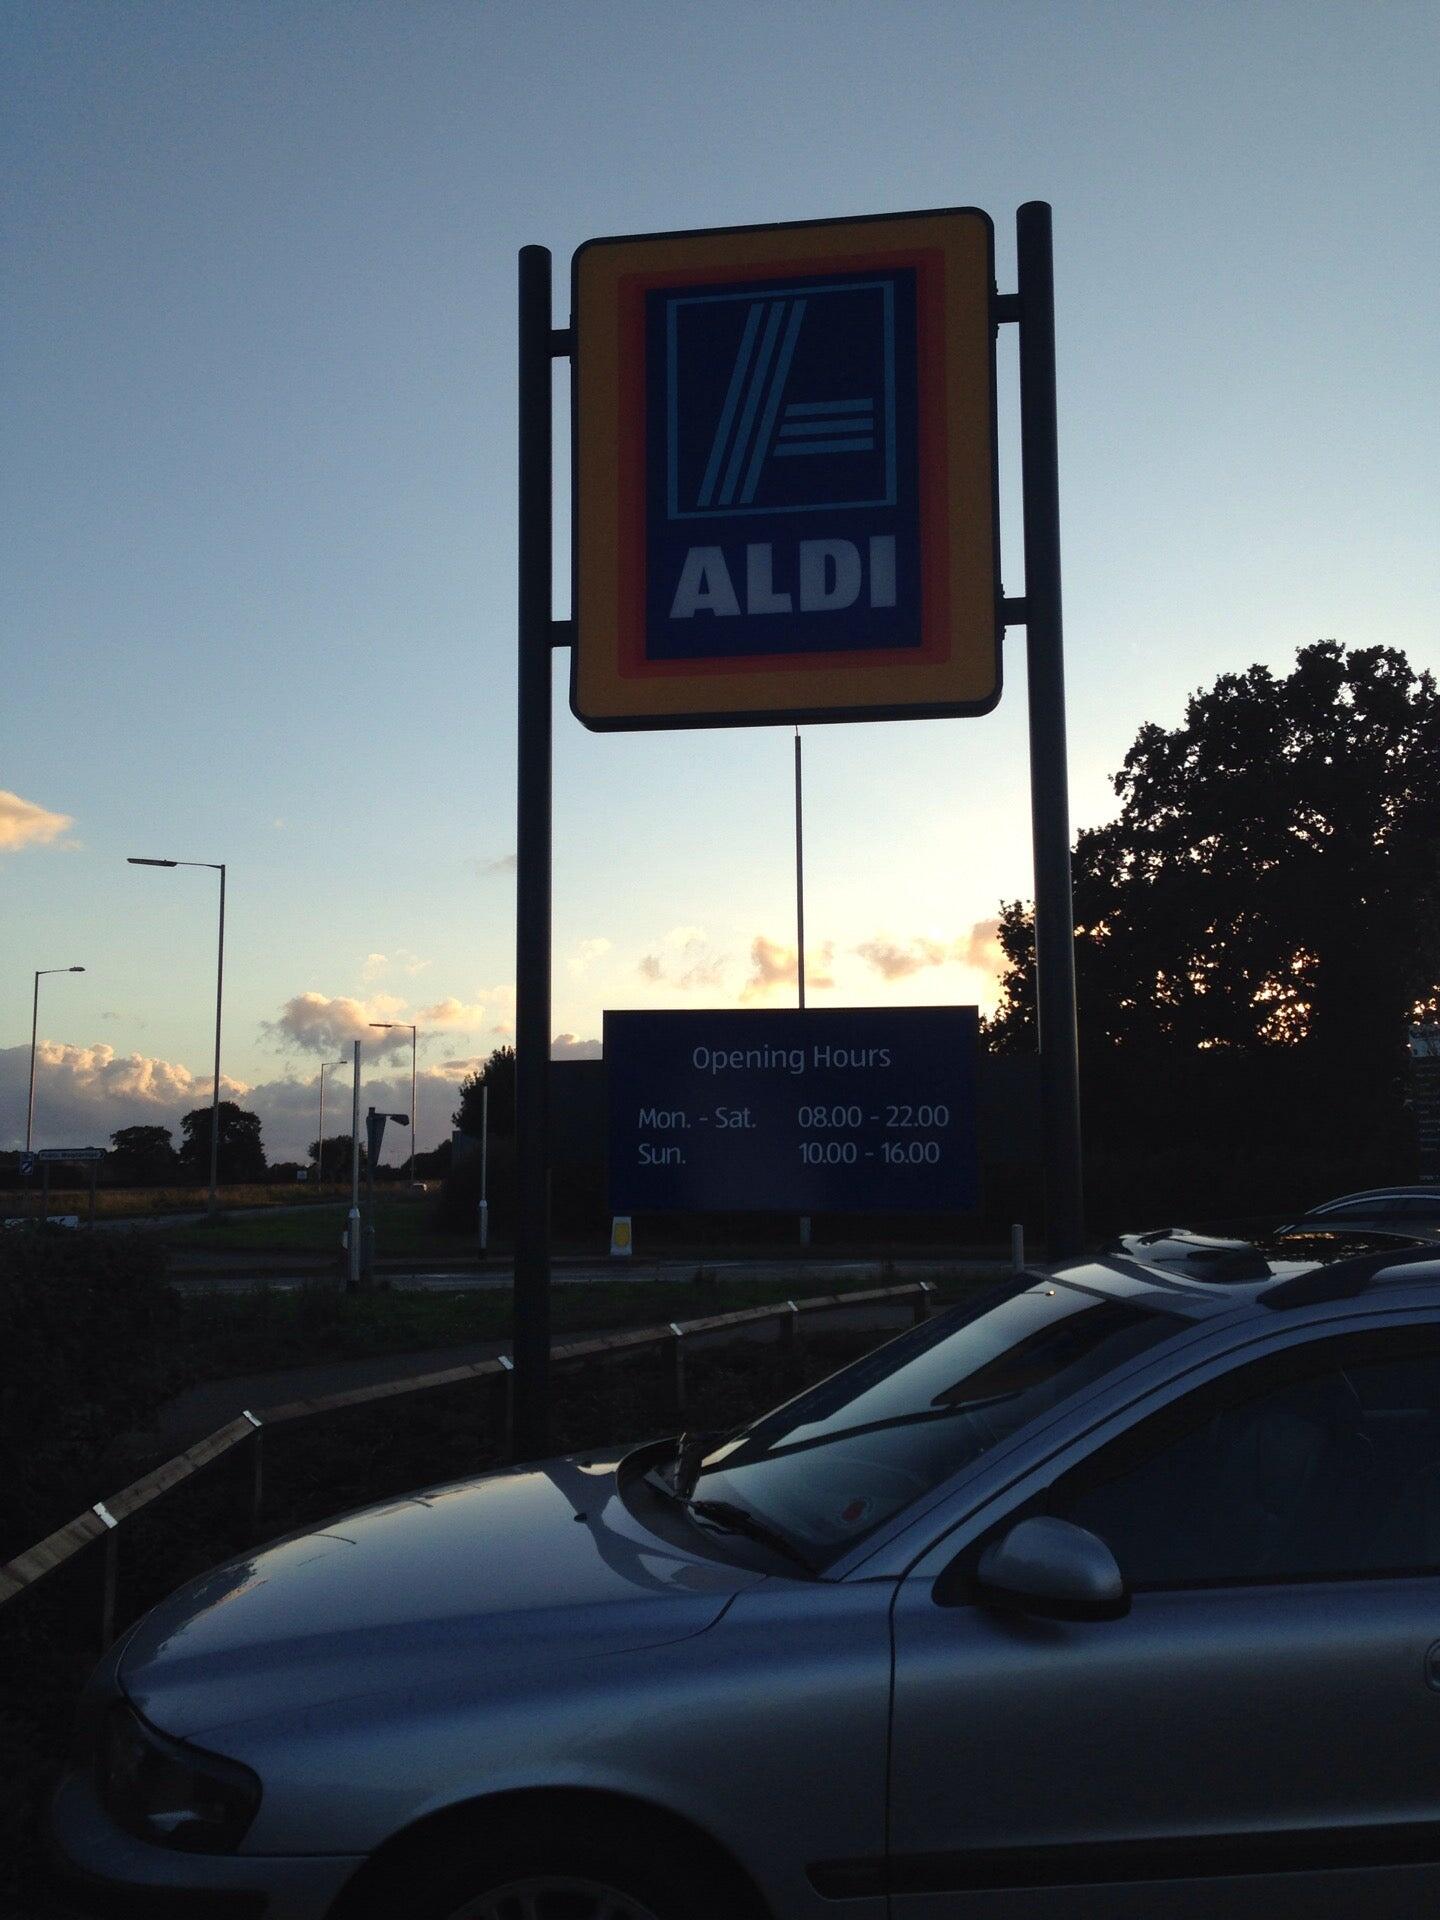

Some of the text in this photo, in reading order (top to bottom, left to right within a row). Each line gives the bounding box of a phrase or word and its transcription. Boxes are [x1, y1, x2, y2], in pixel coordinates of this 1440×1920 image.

[668, 535, 897, 620] ALDI
[692, 1044, 892, 1074] Opening Hours
[638, 1107, 692, 1129] Mon.
[715, 1107, 756, 1128] Sat.
[798, 1105, 863, 1128] 08.00
[886, 1105, 949, 1127] 22.00
[637, 1143, 686, 1165] Sun.
[799, 1142, 858, 1164] 10.00
[881, 1142, 940, 1164] 16.00
